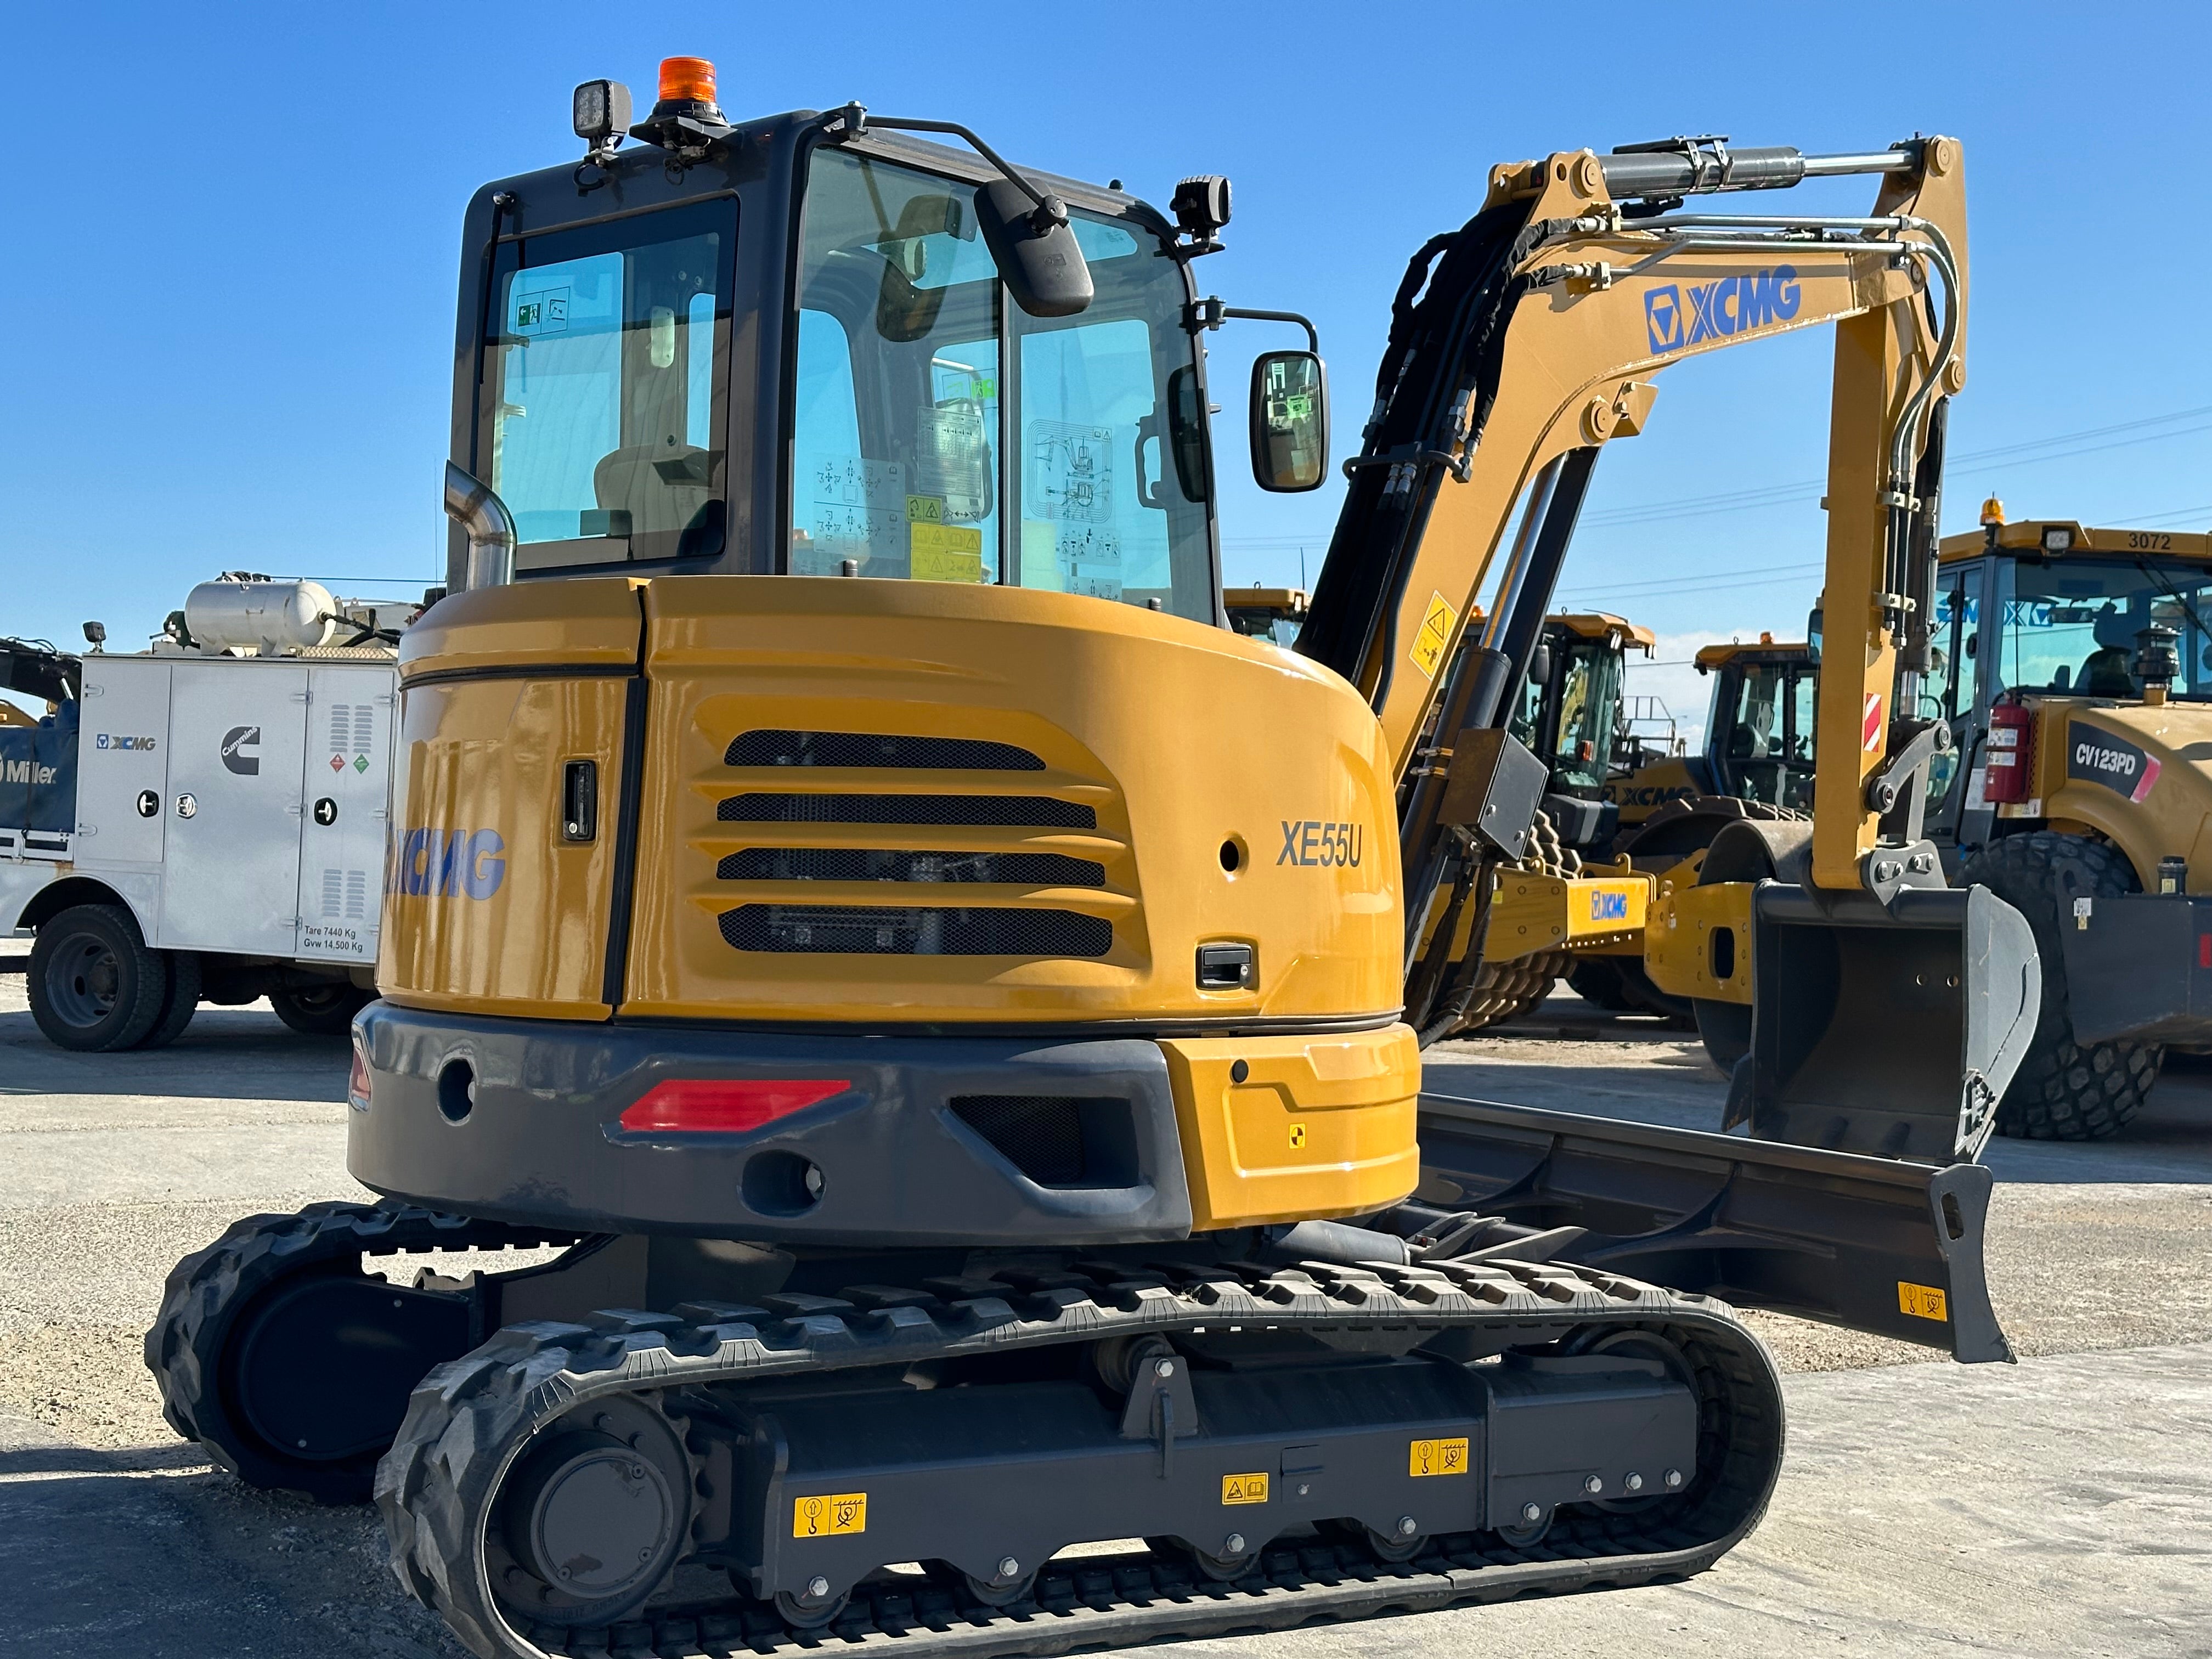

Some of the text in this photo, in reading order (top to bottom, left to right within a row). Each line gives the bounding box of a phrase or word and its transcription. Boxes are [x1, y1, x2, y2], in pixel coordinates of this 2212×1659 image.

[1684, 264, 1801, 347] XCMG
[2129, 532, 2171, 550] 3072
[110, 736, 156, 751] XCMG
[222, 726, 258, 756] Cummins
[2076, 743, 2136, 775] CV123PD
[1276, 821, 1362, 867] XE55U
[1601, 893, 1627, 918] XCMG
[304, 926, 356, 940] Tare 7440 Kg
[304, 938, 363, 953] Gvw 14,500 Kg
